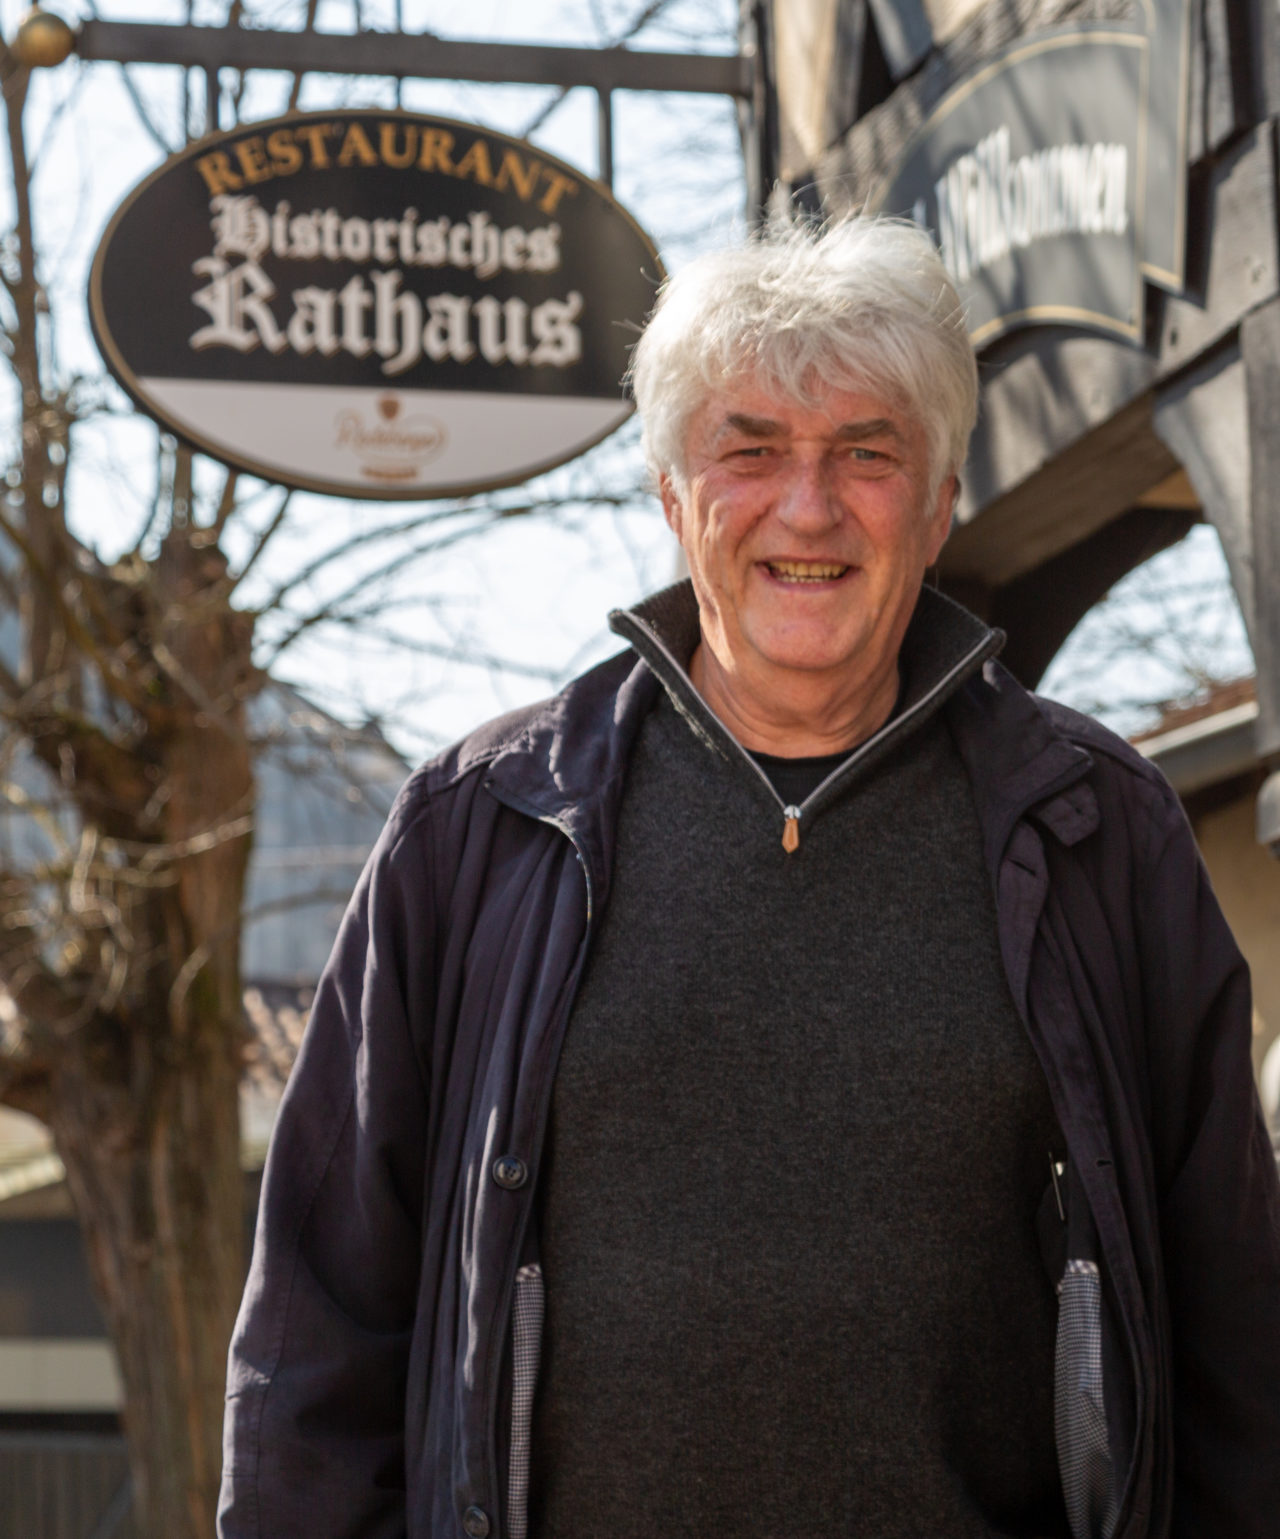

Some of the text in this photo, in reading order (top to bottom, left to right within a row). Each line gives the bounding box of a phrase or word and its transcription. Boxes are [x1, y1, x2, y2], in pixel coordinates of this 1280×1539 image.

[195, 120, 580, 215] RESTAURANT
[209, 193, 561, 279] Historisches
[189, 256, 583, 376] Rathaus
